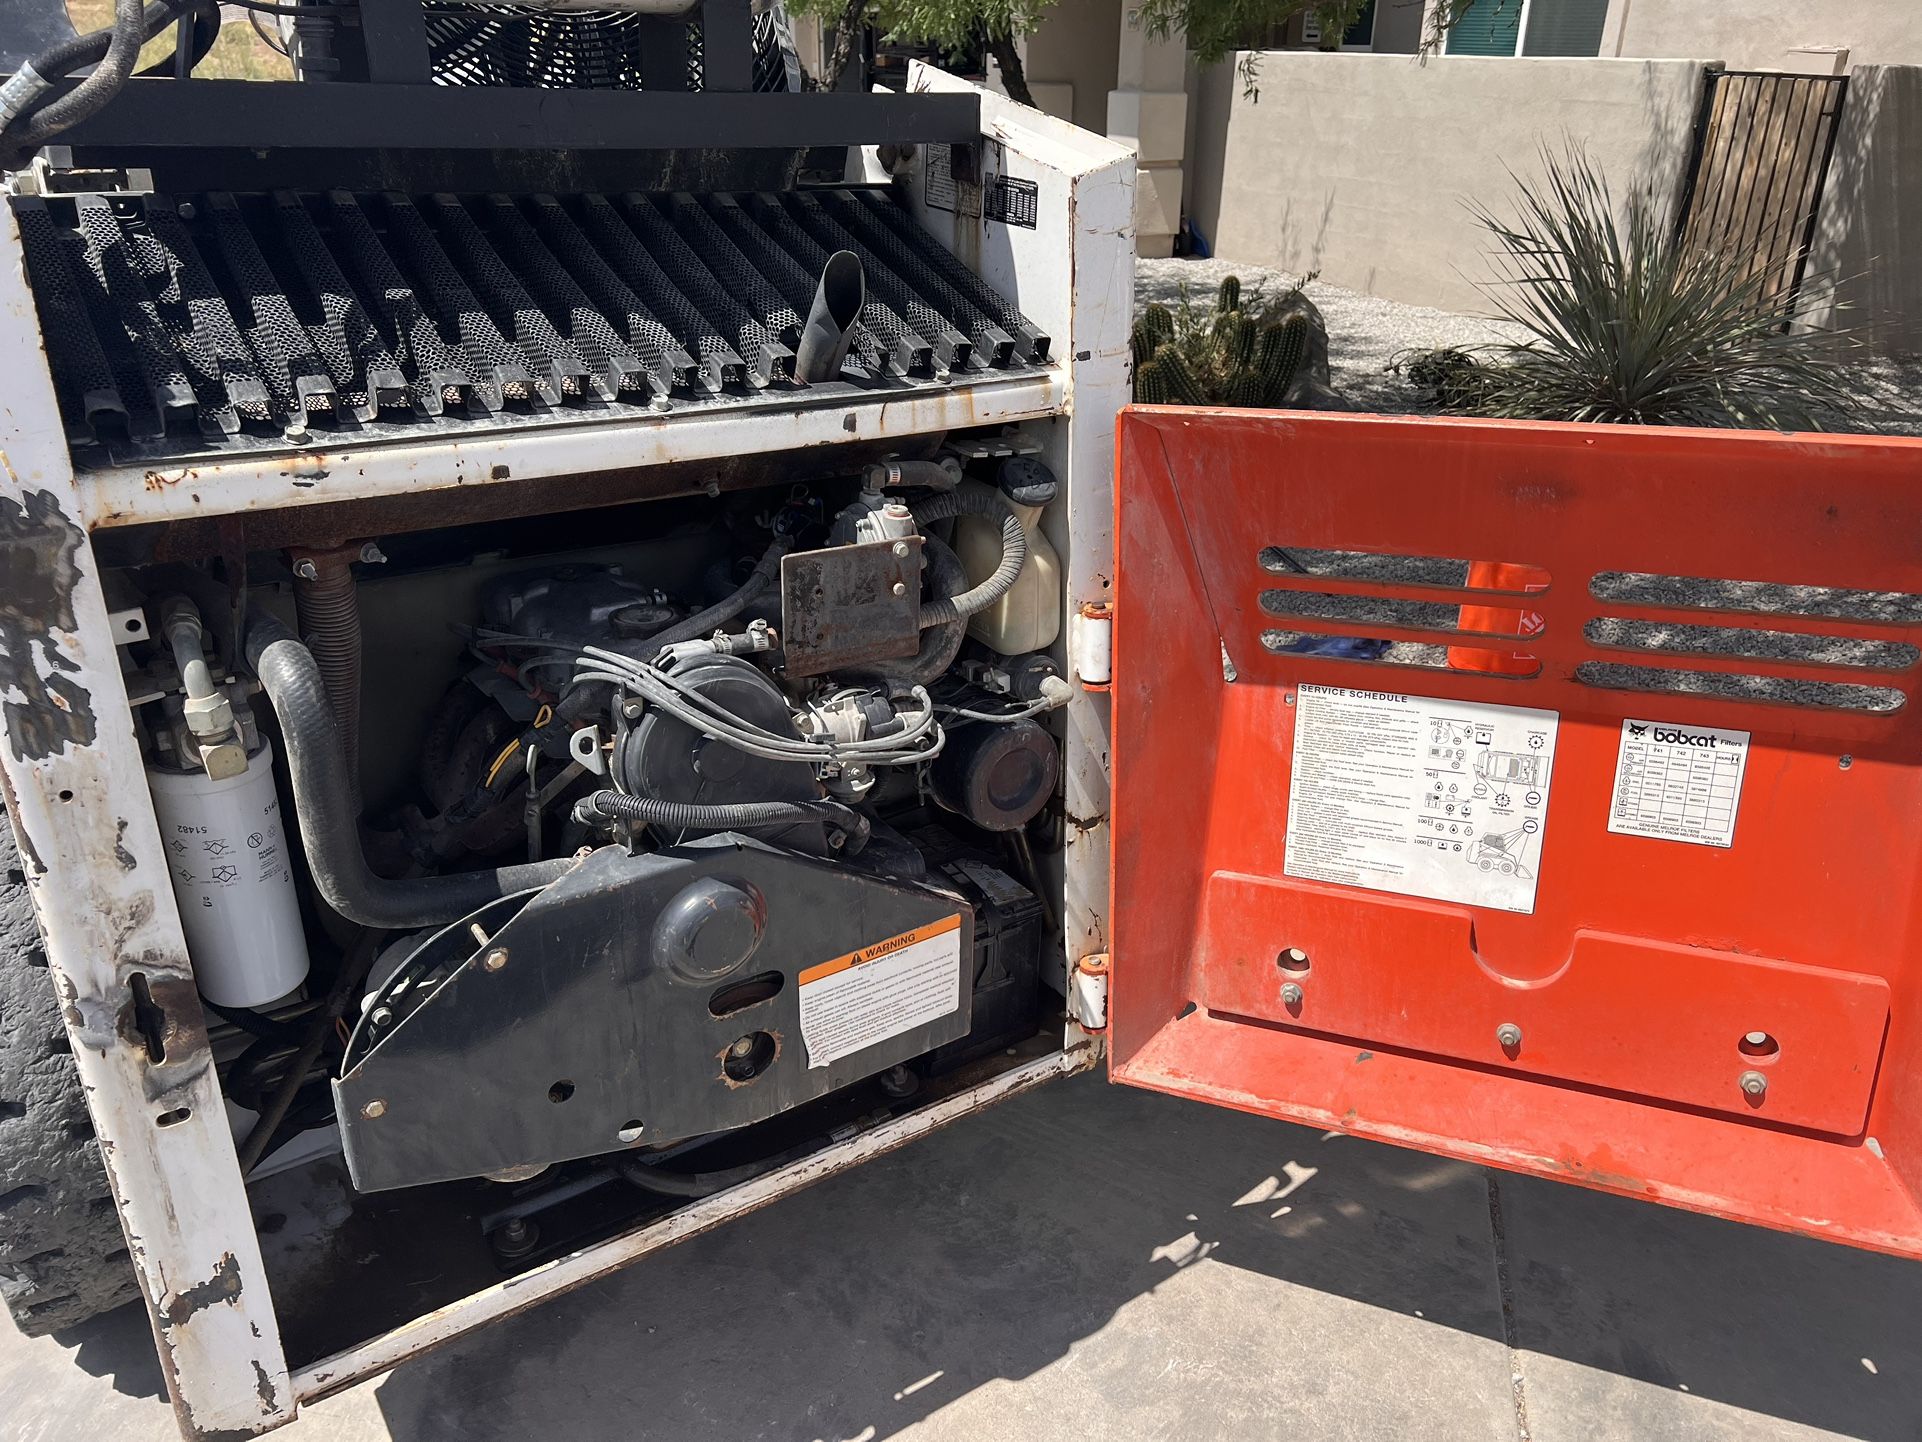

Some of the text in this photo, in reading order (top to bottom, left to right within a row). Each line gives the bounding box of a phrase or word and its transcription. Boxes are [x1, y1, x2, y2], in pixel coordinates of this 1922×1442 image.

[1300, 684, 1408, 703] SERVICE SCHEDULE
[1654, 727, 1717, 748] bobcat
[1720, 739, 1742, 747] Filters
[177, 825, 207, 834] 51482
[866, 934, 915, 957] WARNING
